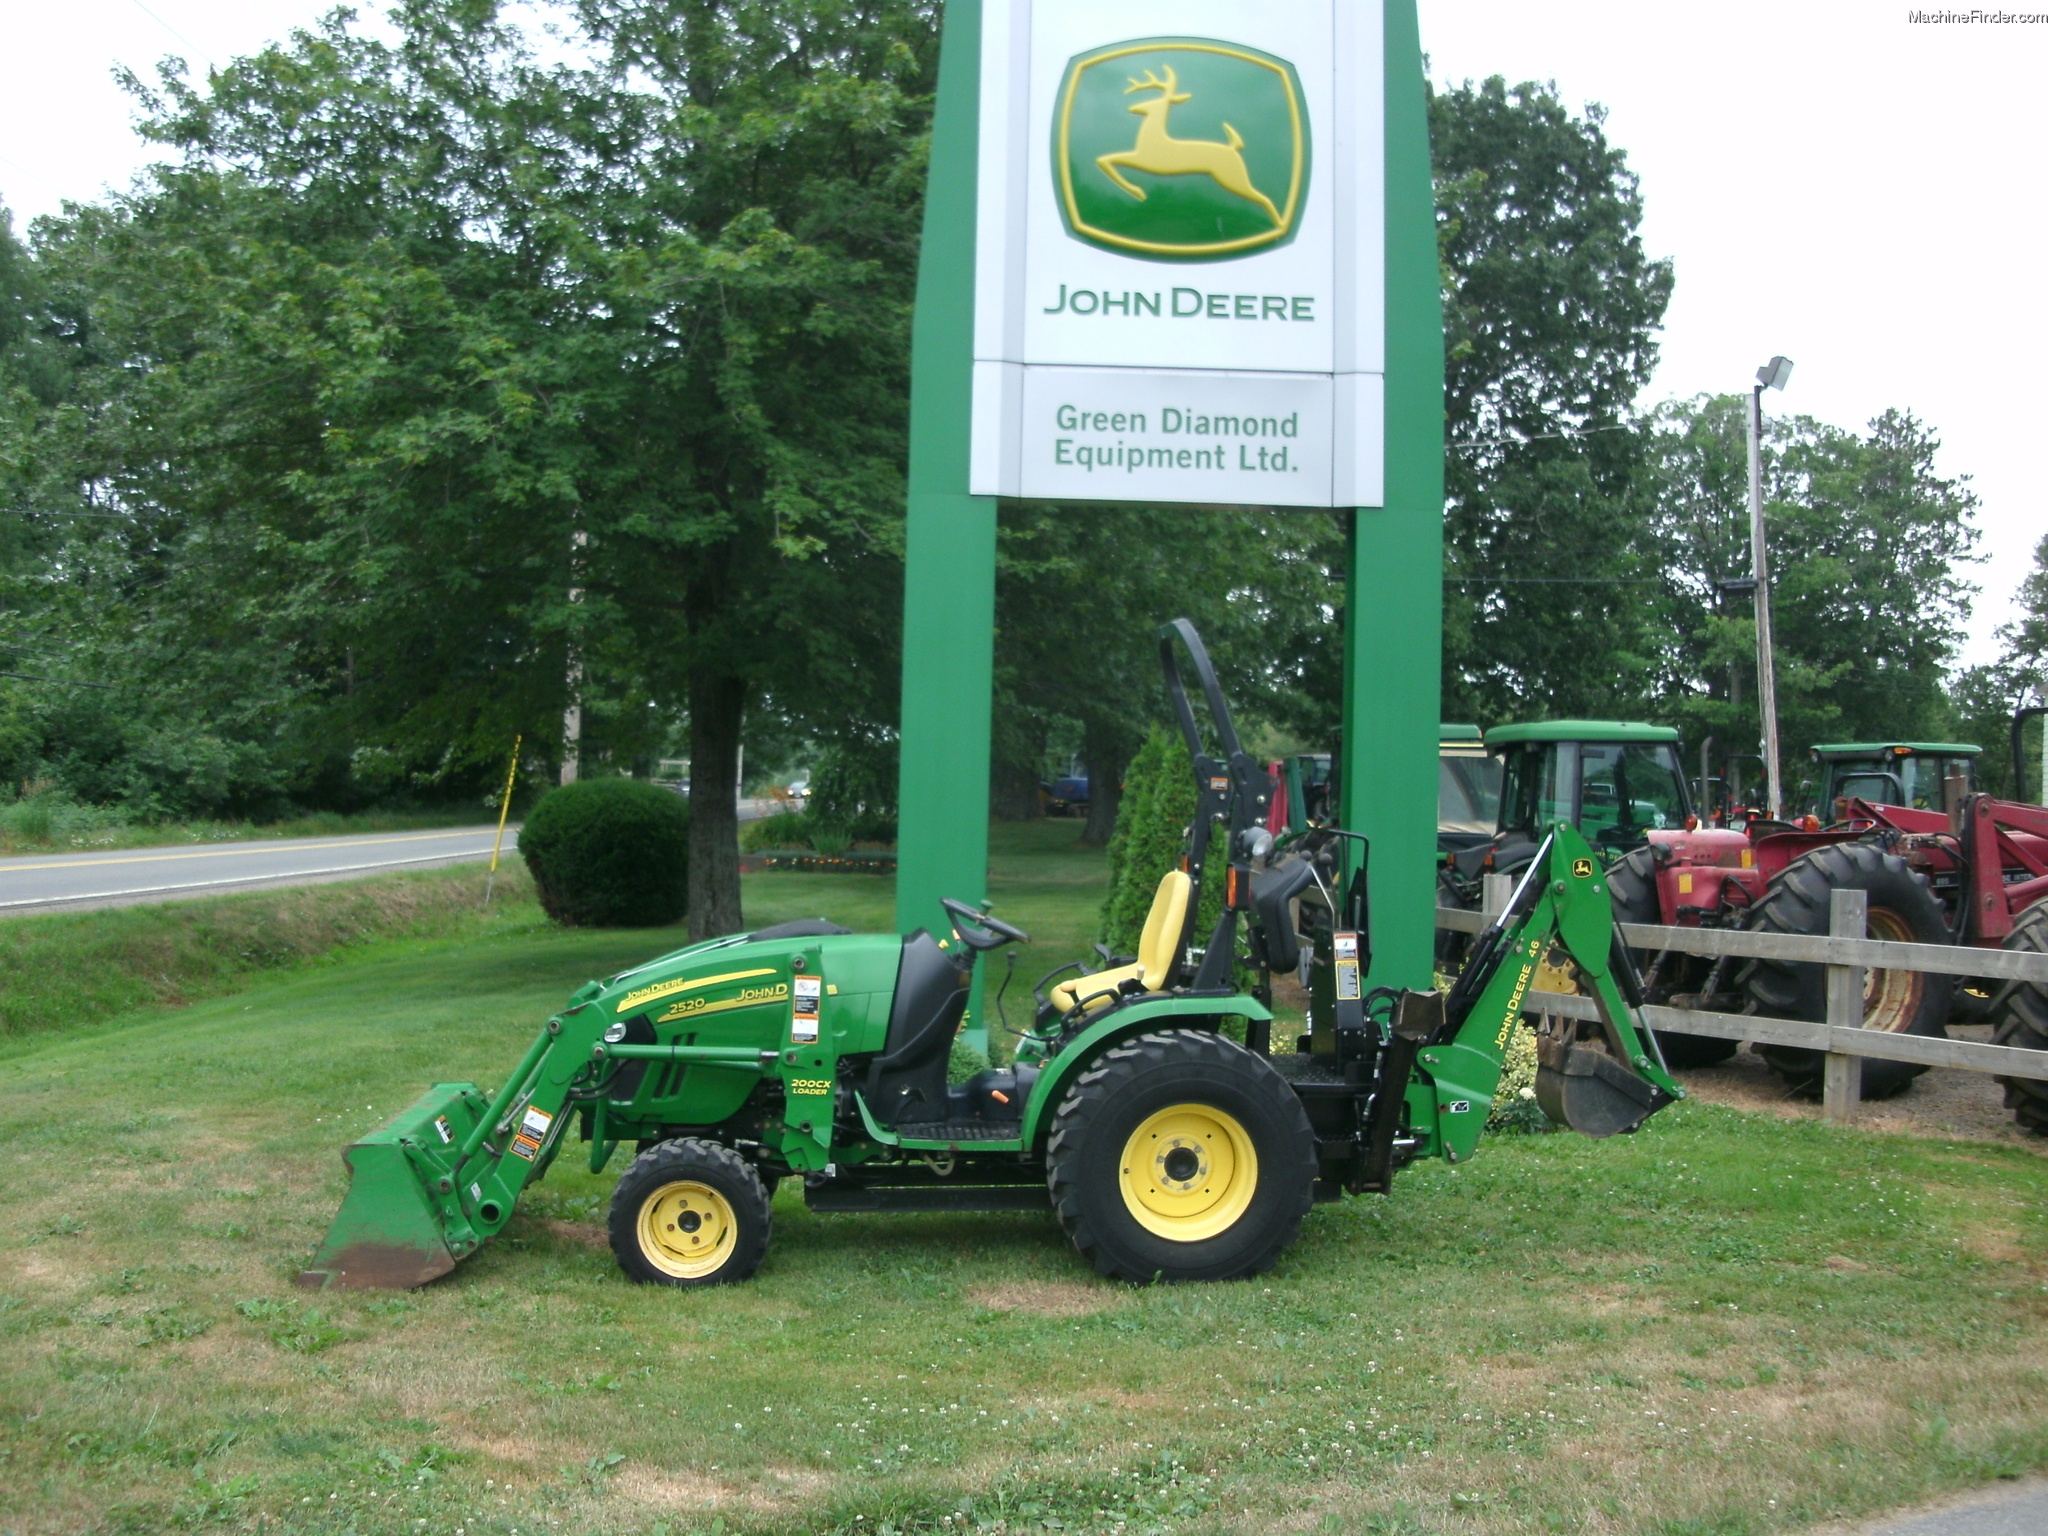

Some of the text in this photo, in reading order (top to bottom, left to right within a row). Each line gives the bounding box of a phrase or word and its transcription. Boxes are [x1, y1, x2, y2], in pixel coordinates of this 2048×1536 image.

[1043, 284, 1315, 321] JOHN DEERE
[1056, 404, 1298, 438] Green Diamond
[1055, 439, 1299, 474] Equipment Ltd.
[626, 977, 685, 1002] JOHN DEERE
[736, 987, 775, 1002] JOHN
[1494, 940, 1540, 1050] JOHN DEERE 46
[670, 997, 706, 1015] 2520
[791, 1079, 832, 1088] 200CX
[793, 1088, 828, 1096] LOADER
